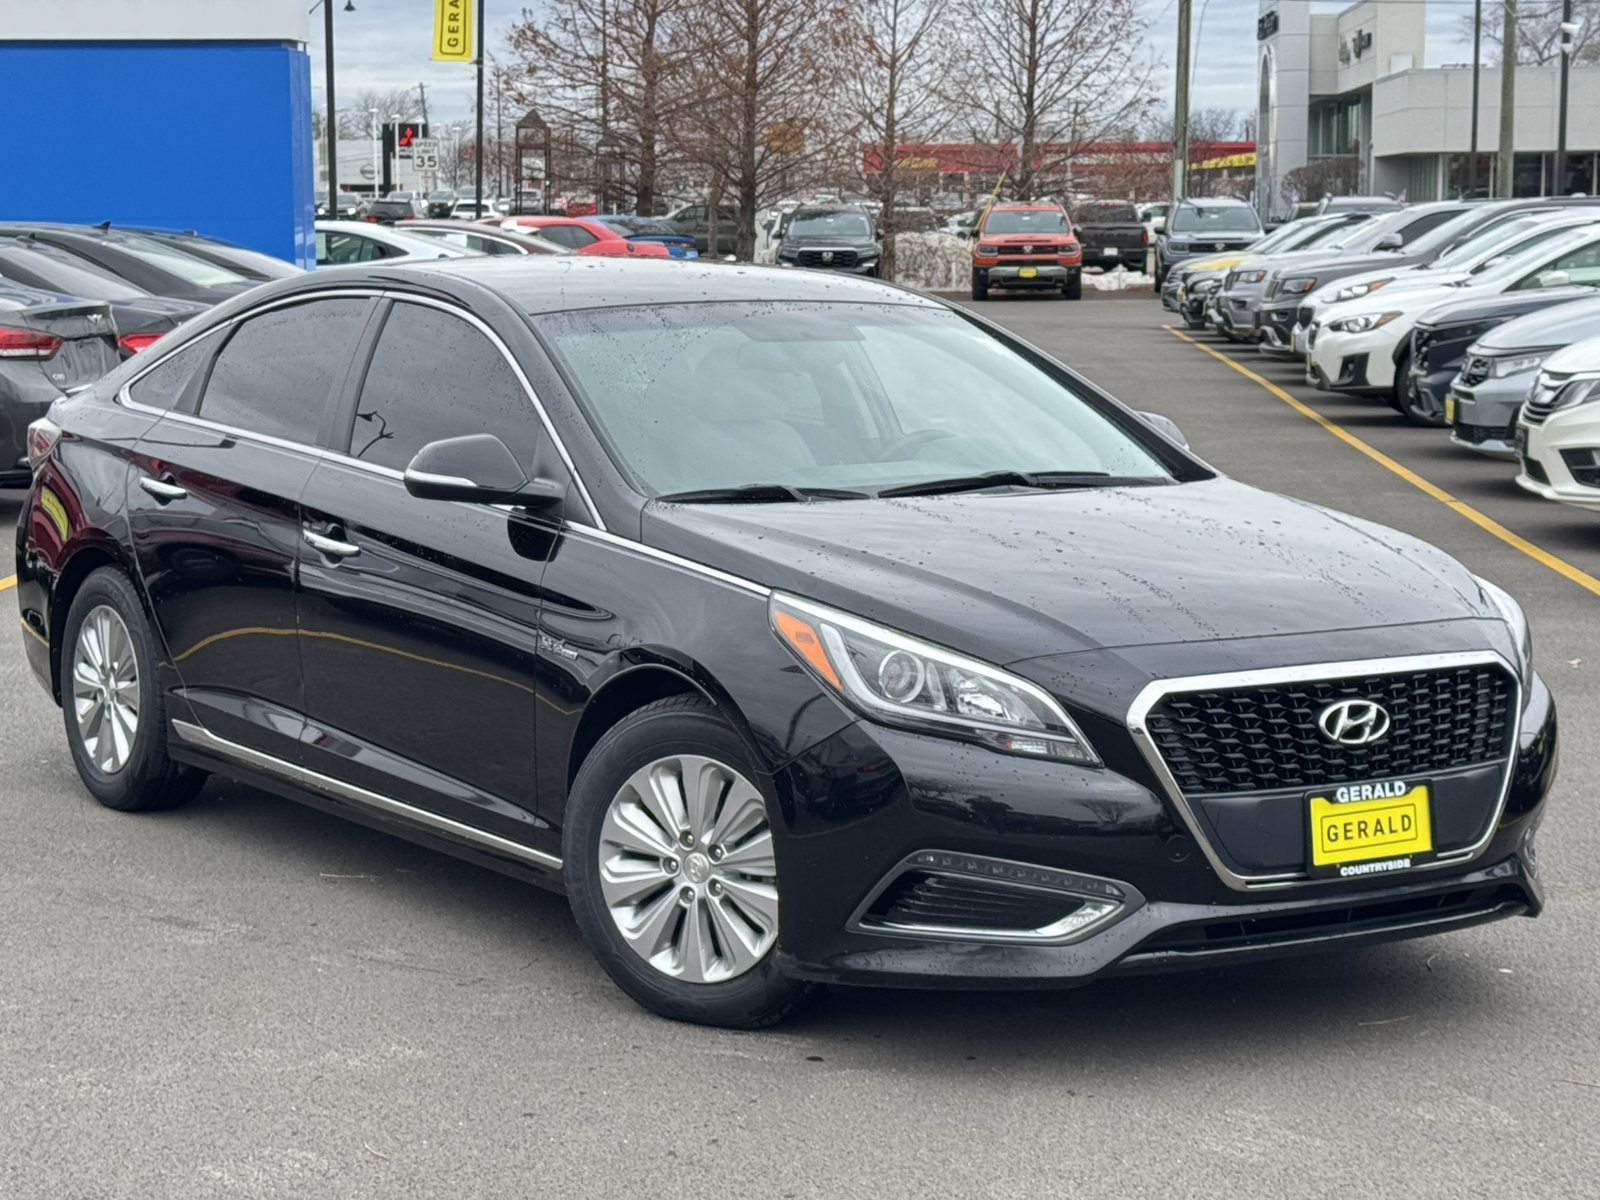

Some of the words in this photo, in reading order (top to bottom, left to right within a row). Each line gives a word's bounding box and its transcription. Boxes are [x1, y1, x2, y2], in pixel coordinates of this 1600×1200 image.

[416, 155, 437, 168] 35
[1336, 781, 1406, 803] GERALD
[1327, 814, 1412, 843] GERALD
[1340, 858, 1411, 876] COUNTRYSIDE
